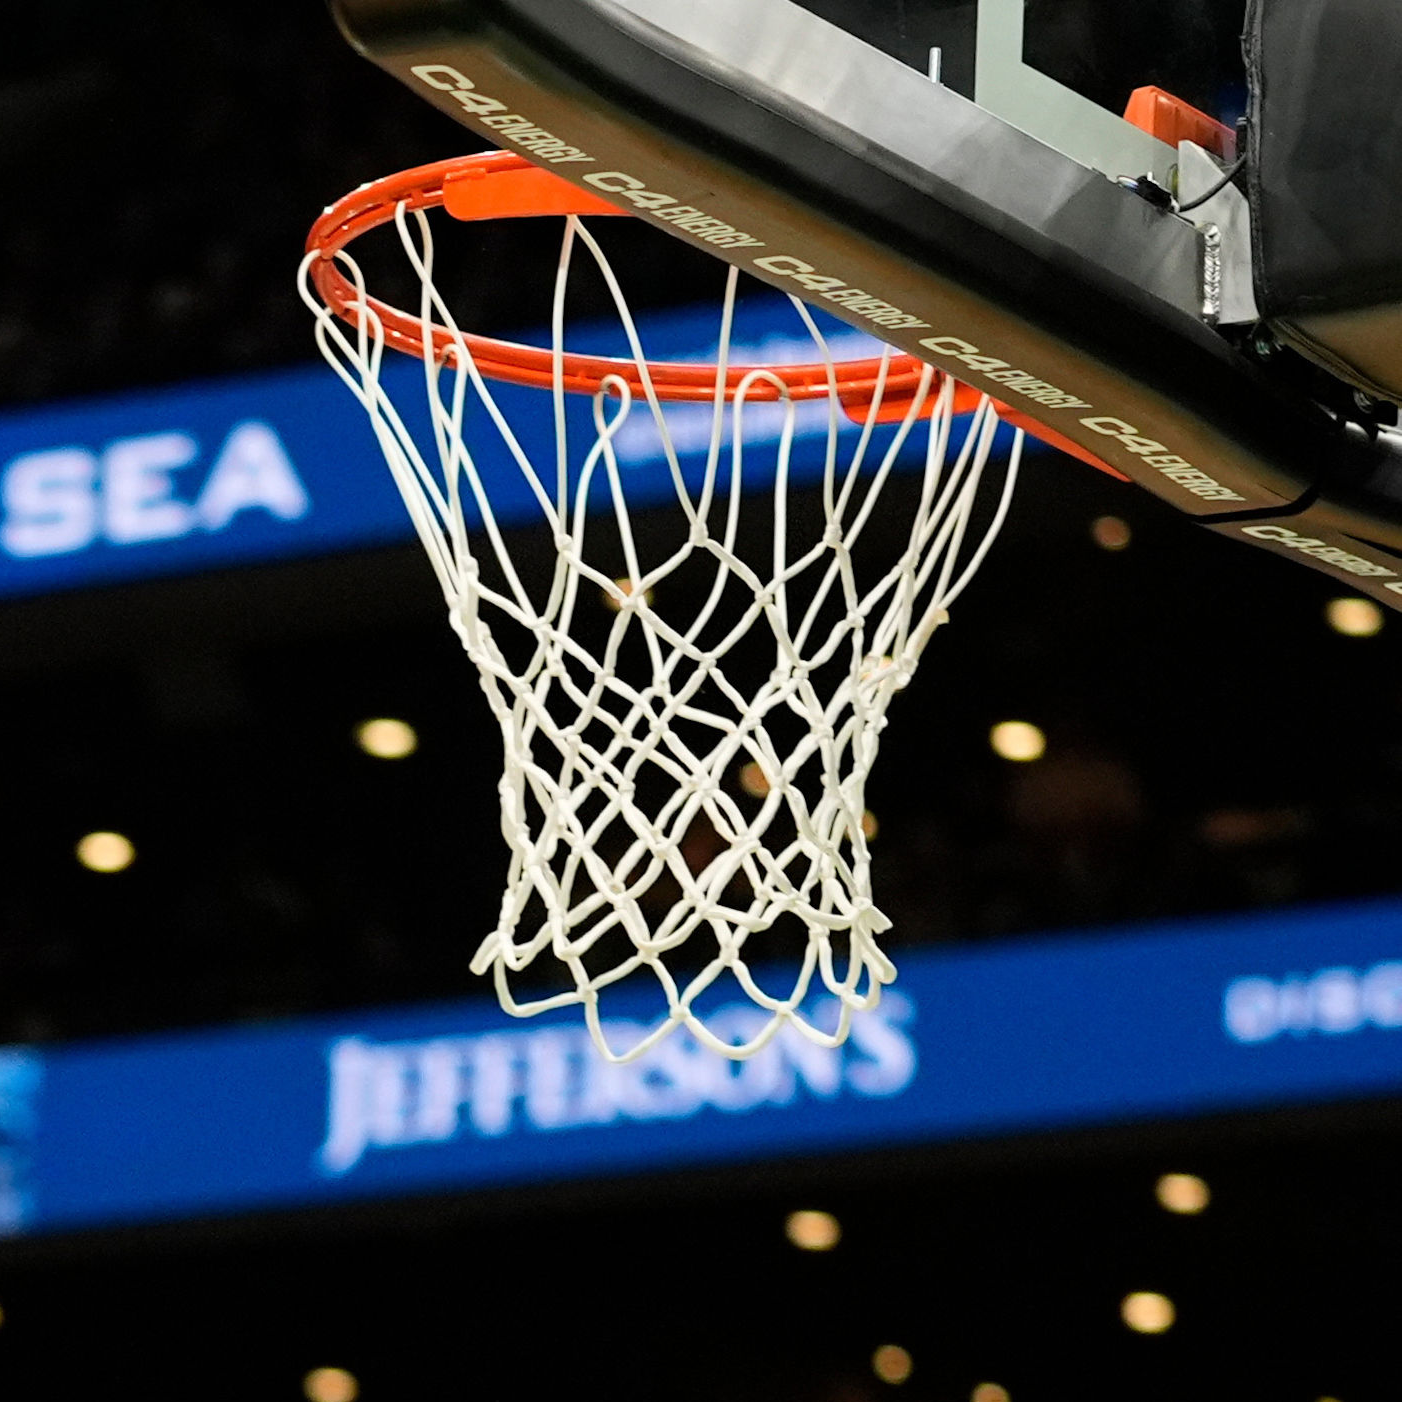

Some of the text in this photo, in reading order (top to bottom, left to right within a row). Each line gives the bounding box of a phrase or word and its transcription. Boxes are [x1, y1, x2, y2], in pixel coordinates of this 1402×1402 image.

[410, 65, 508, 116] C4
[479, 114, 595, 164] ENERGY
[582, 171, 678, 211] C4
[659, 206, 766, 249] ENERGY
[752, 255, 846, 292] C4
[827, 289, 932, 330] ENERGY
[918, 336, 1011, 372] C4
[992, 369, 1093, 410] ENERGY
[1079, 416, 1169, 455] C4
[1147, 454, 1248, 502] ENERGY
[1241, 525, 1326, 553] C4
